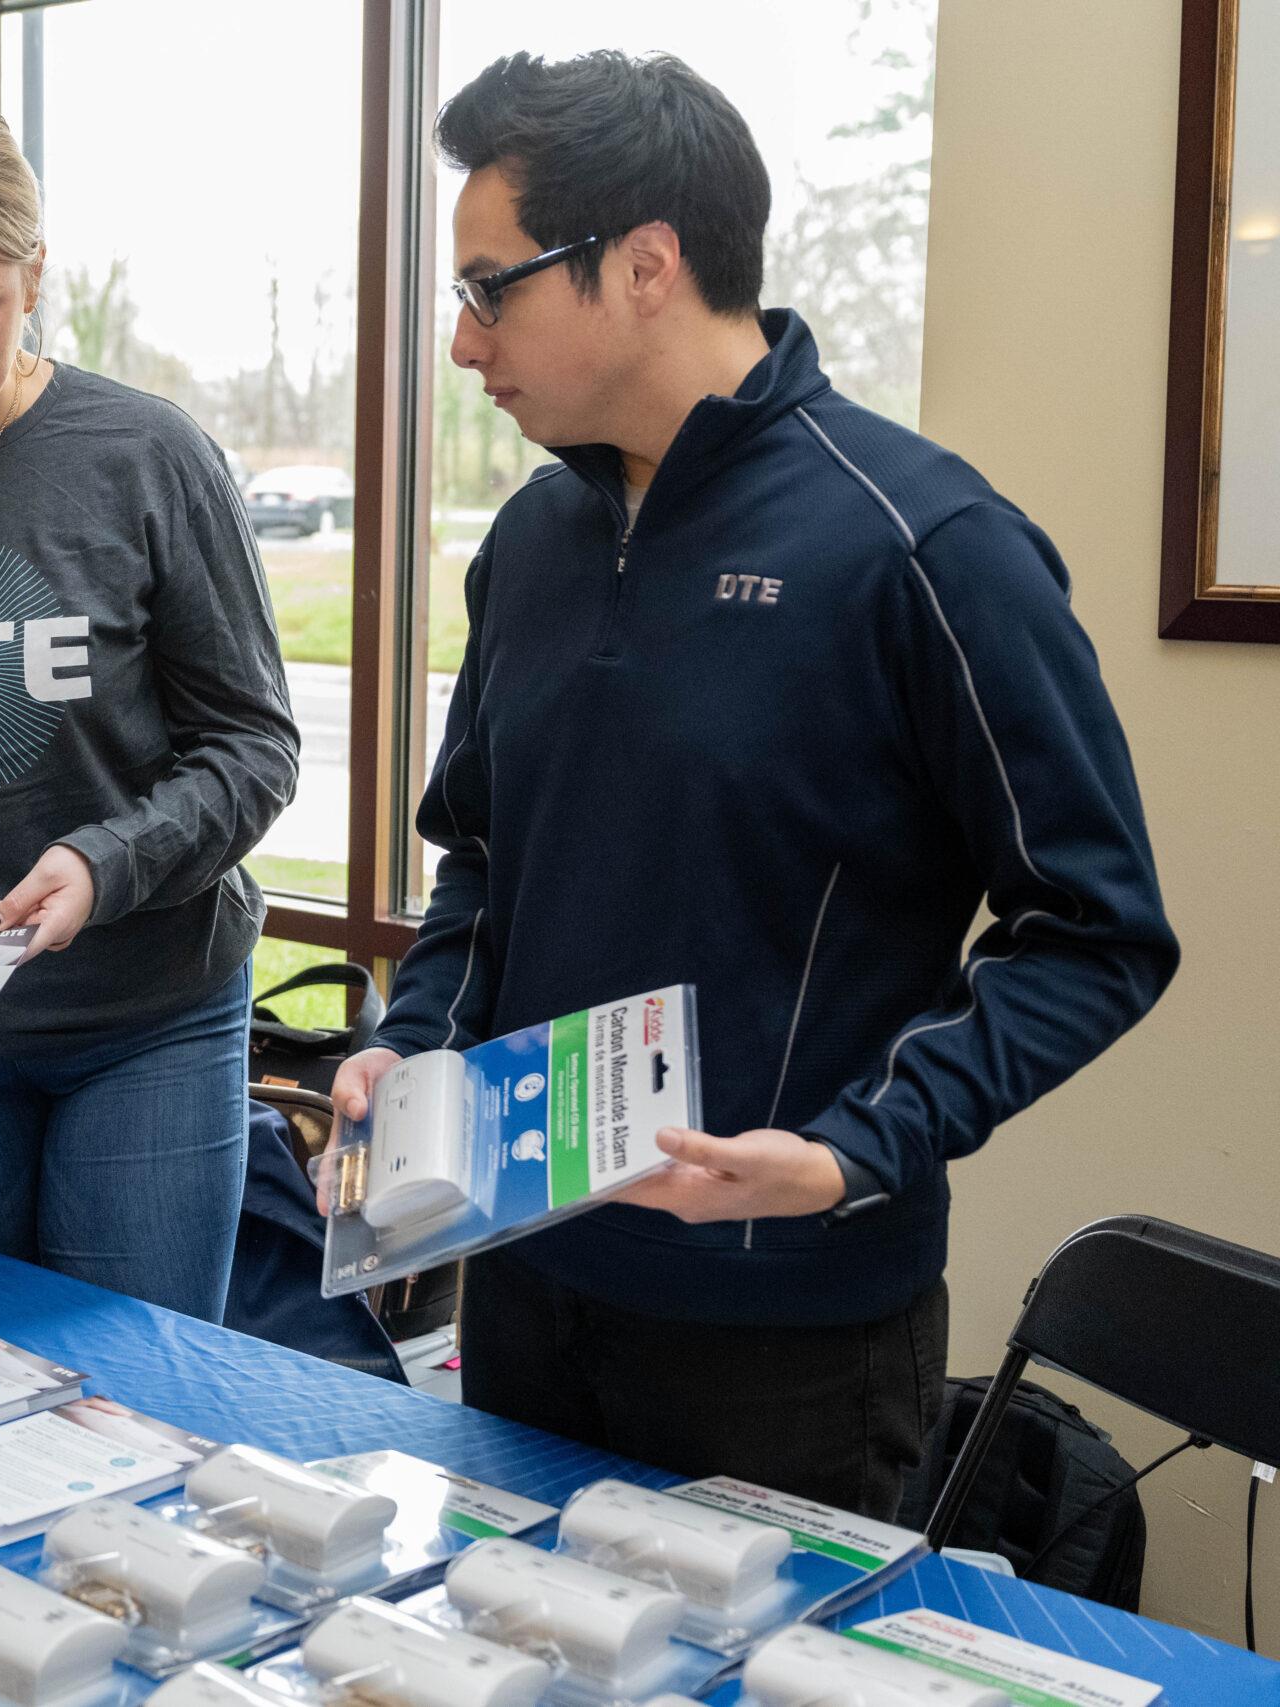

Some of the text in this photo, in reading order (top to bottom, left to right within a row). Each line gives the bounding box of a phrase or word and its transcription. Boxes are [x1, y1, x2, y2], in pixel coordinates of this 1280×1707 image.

[714, 573, 784, 605] DTE
[0, 928, 27, 937] DTE
[596, 1014, 607, 1049] Alarma
[649, 1006, 664, 1042] Kidde
[595, 1050, 605, 1062] de
[611, 1006, 629, 1170] Carbon Monoxide Alarm
[596, 1112, 606, 1127] de
[596, 1128, 606, 1173] carbono
[687, 1486, 891, 1550] Carbon Monoxide Alarm
